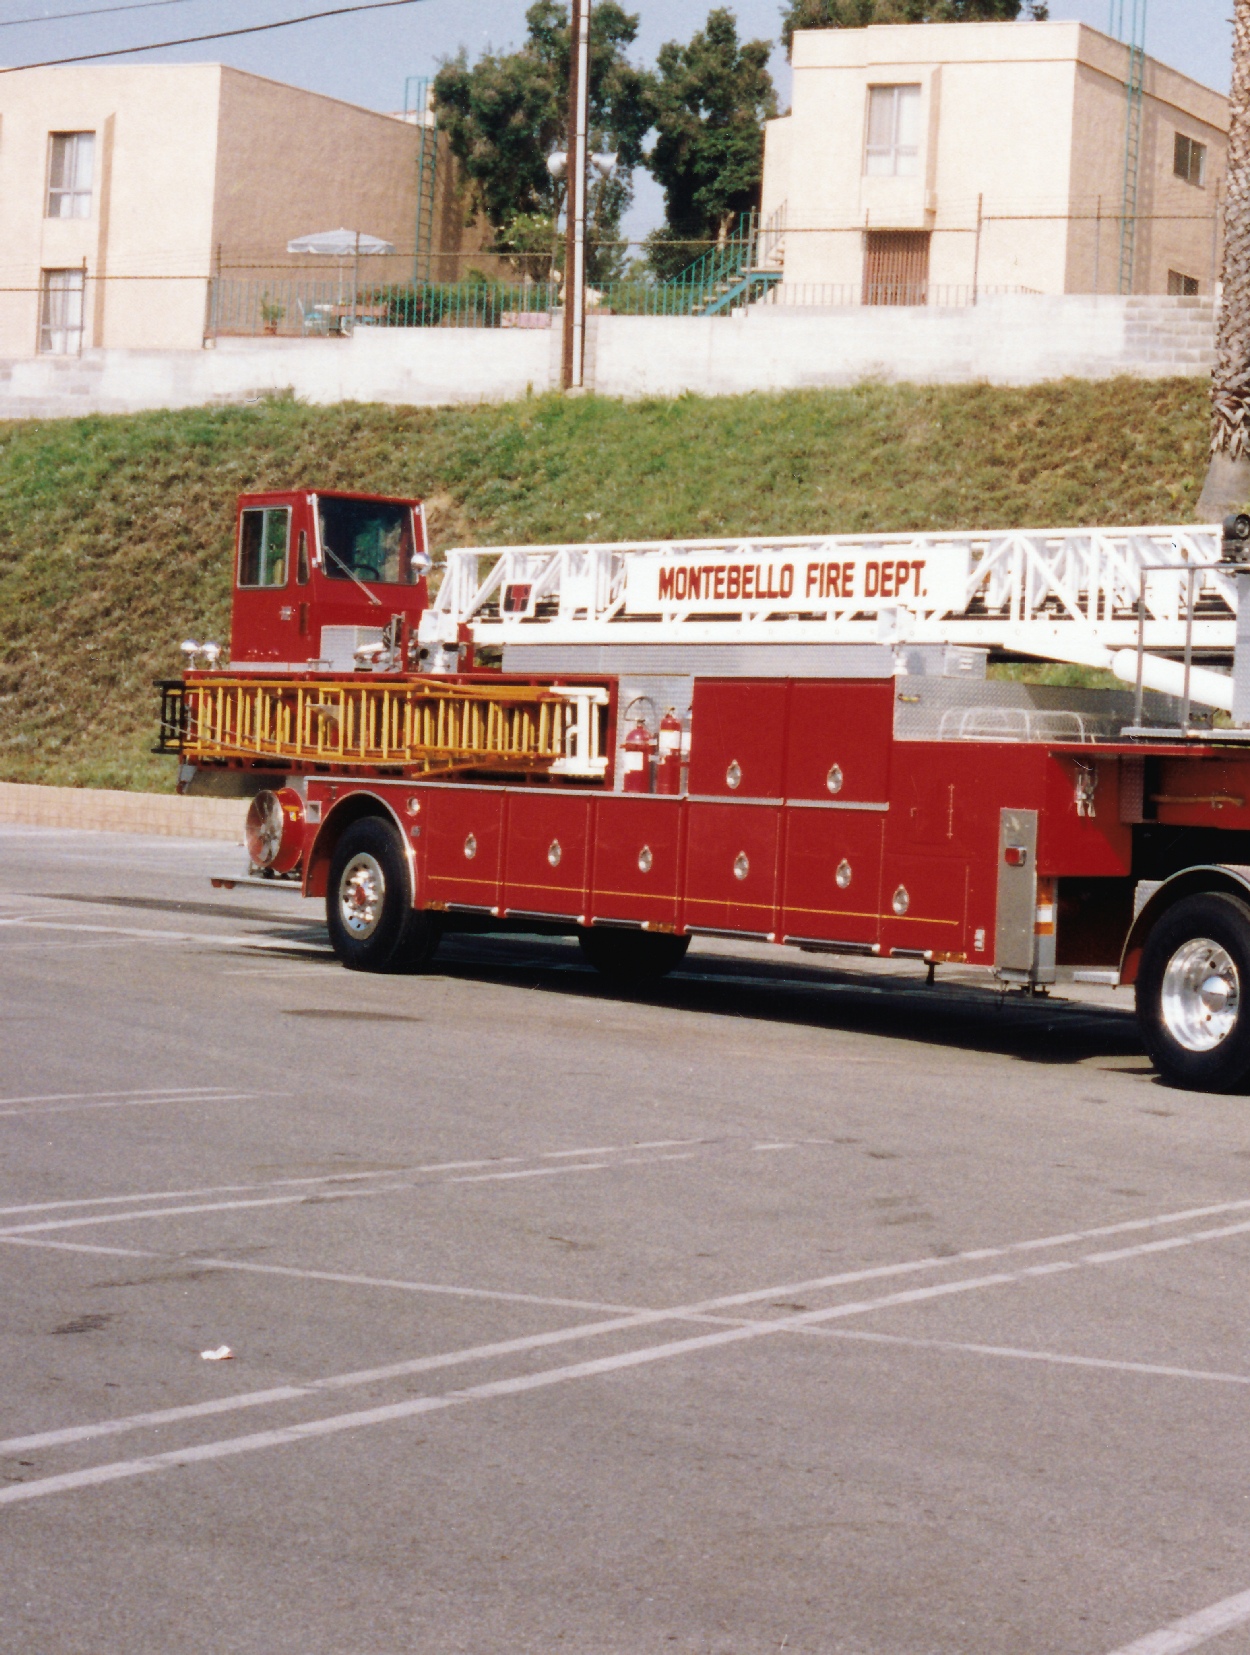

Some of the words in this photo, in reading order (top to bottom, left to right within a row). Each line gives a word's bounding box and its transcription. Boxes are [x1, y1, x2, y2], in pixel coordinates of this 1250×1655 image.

[658, 563, 795, 600] MONTEBELLO
[805, 561, 856, 598] FIRE
[863, 559, 928, 597] DEPT.
